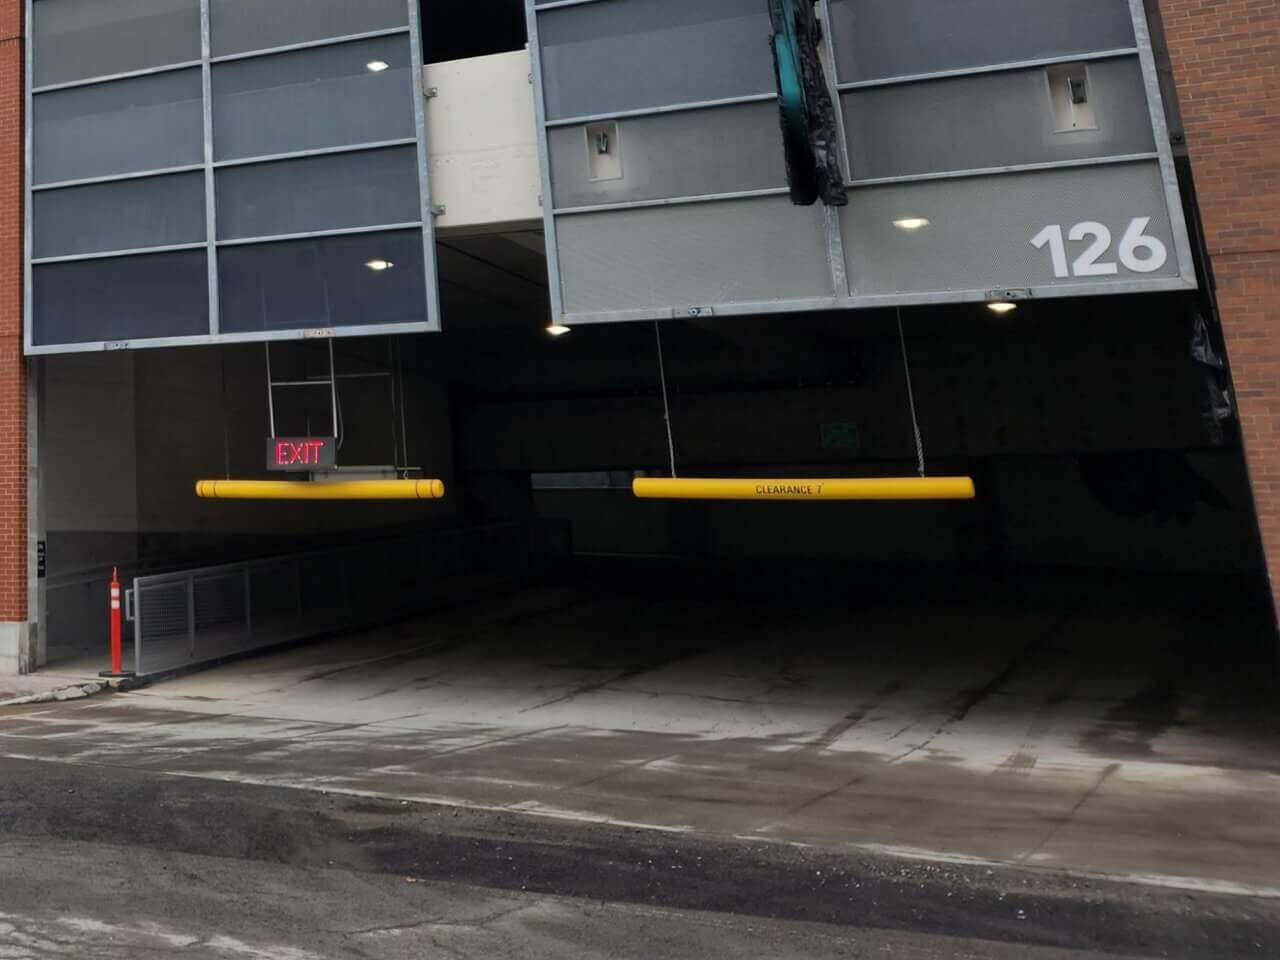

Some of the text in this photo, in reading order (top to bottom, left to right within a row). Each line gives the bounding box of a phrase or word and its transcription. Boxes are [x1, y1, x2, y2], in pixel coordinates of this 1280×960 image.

[1030, 216, 1168, 278] 126
[275, 440, 326, 465] EXIT
[755, 484, 813, 495] CLEARANCE
